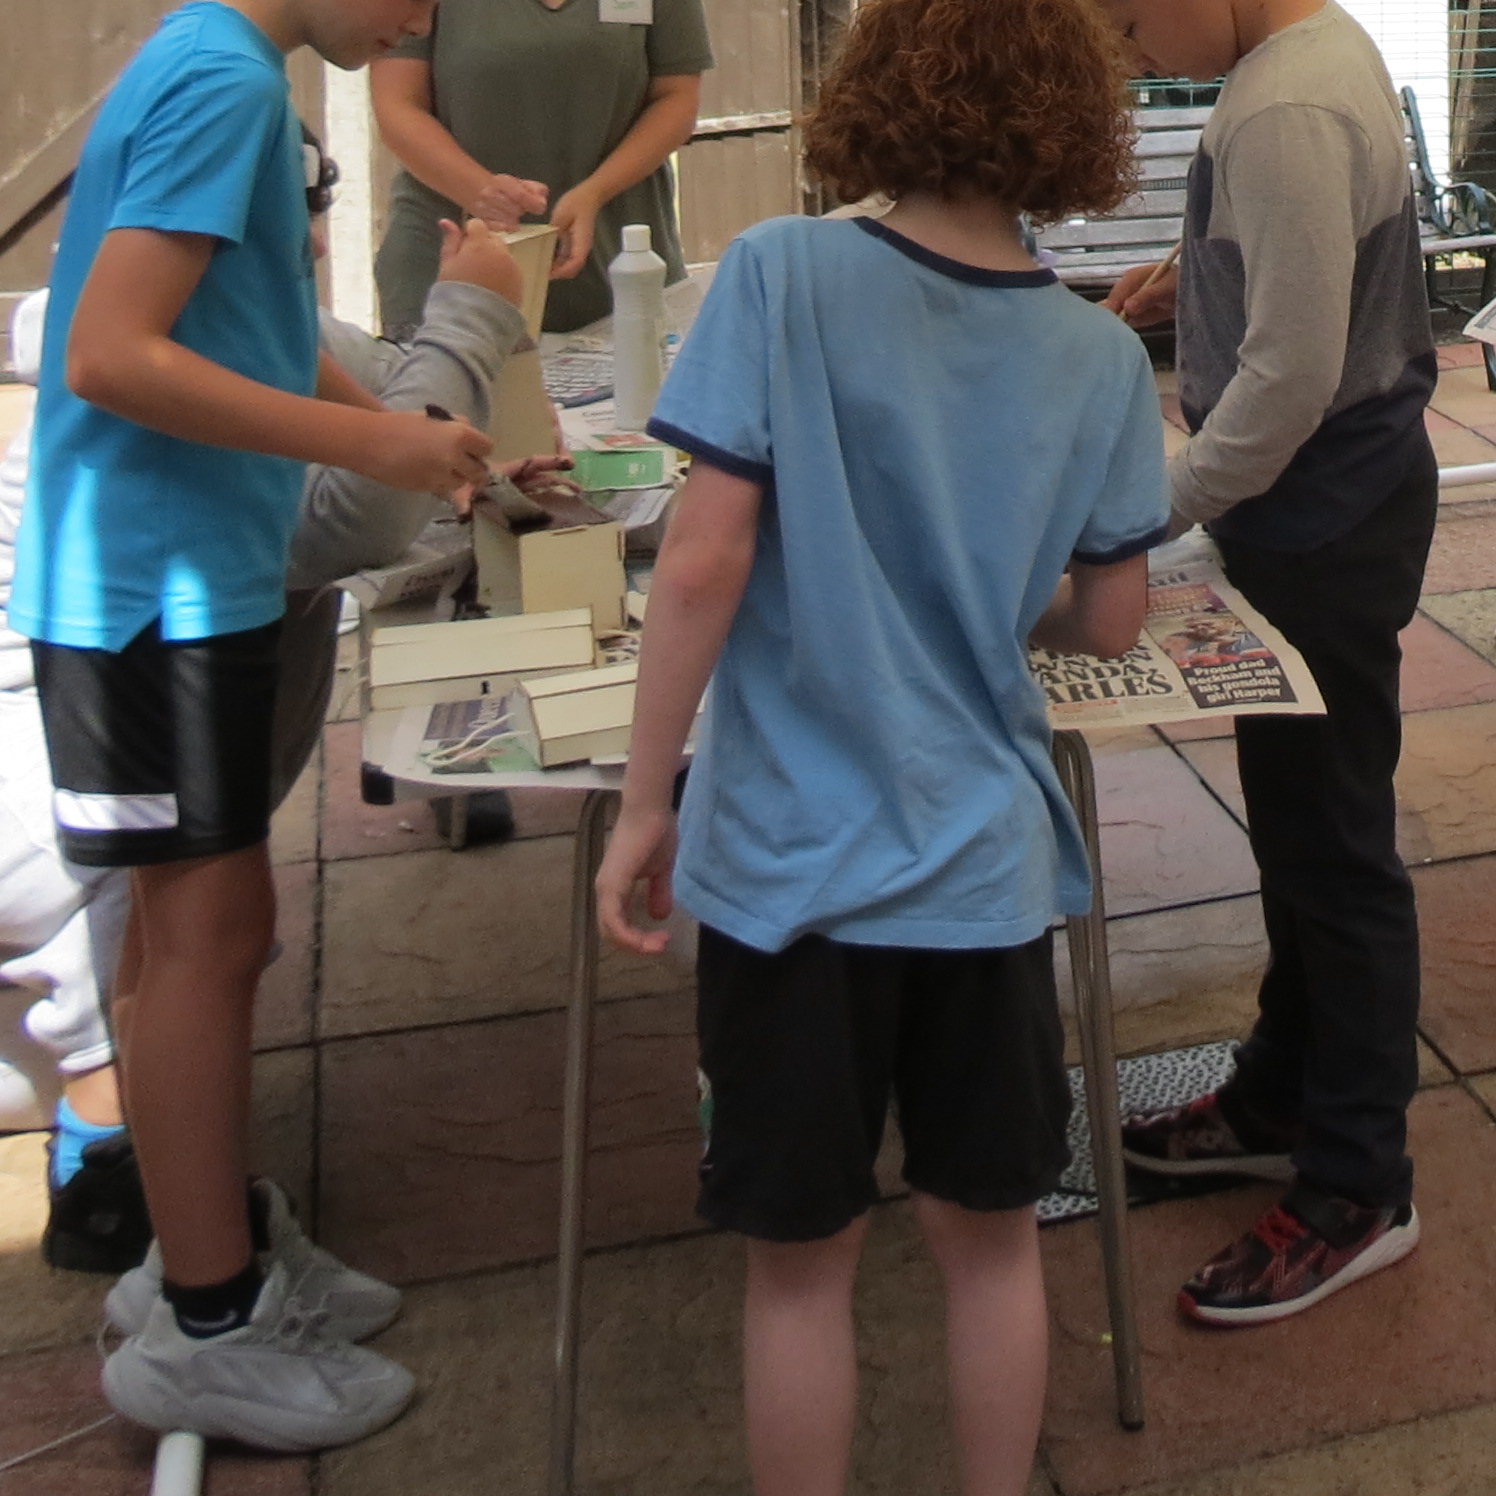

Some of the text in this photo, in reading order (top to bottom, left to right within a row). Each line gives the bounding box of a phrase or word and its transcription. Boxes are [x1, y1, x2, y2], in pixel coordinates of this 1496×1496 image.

[1040, 663, 1158, 685] ANDA,
[1187, 666, 1282, 685] Beckham and
[1193, 659, 1265, 676] Proud dad
[1045, 674, 1173, 704] ARLES
[1197, 677, 1281, 693] his gondola
[1207, 692, 1232, 703] girl
[1233, 688, 1281, 699] Harper
